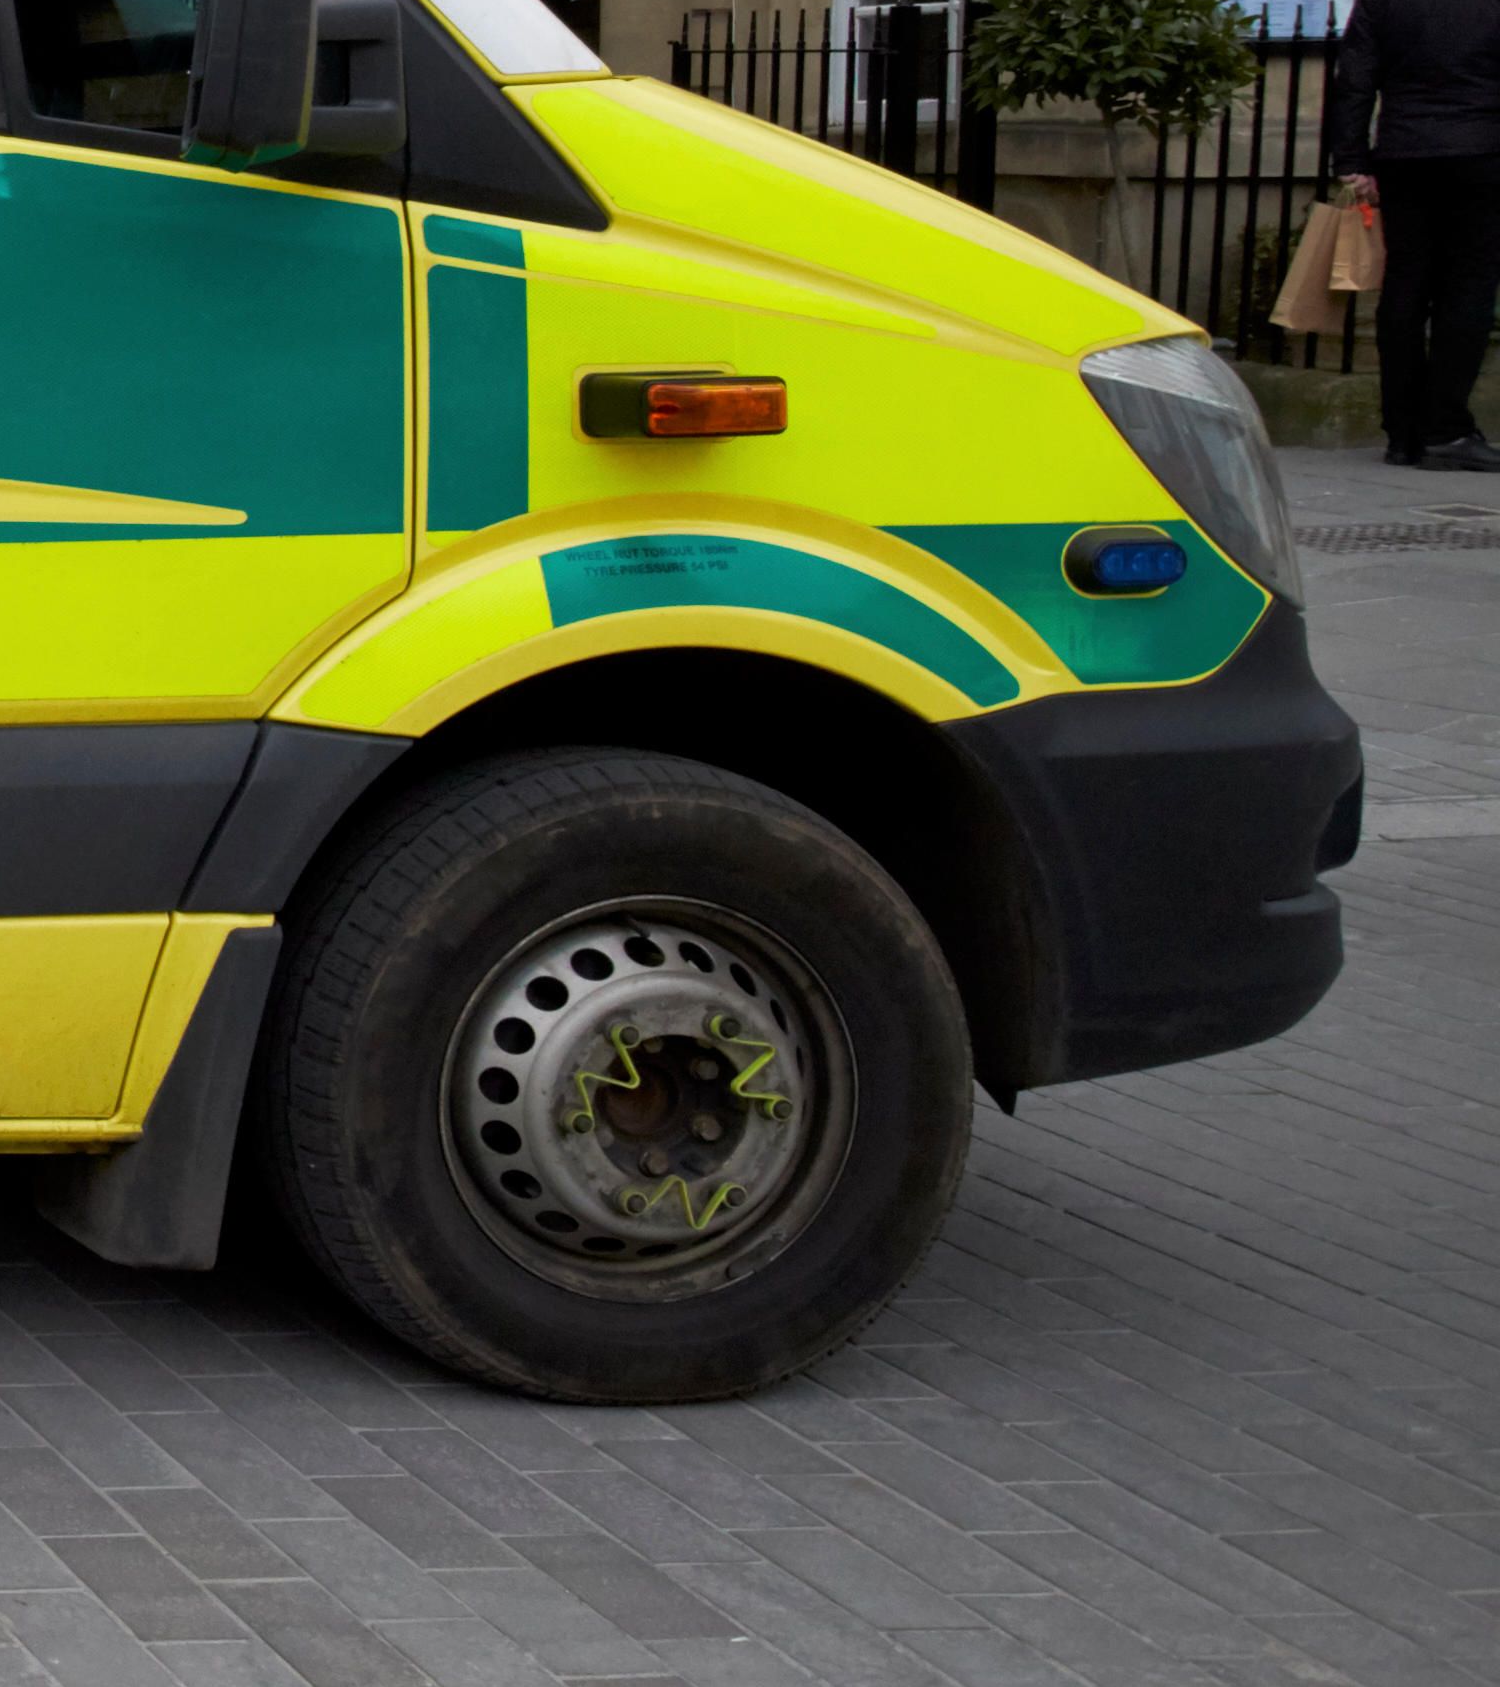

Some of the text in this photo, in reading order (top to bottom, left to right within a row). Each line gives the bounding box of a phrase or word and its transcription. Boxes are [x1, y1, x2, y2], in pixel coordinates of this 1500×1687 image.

[564, 549, 612, 562] WHEEL
[614, 547, 641, 560] NUT
[642, 545, 695, 558] TORQUE
[583, 565, 619, 577] TYRE
[620, 561, 688, 576] PRESSURE
